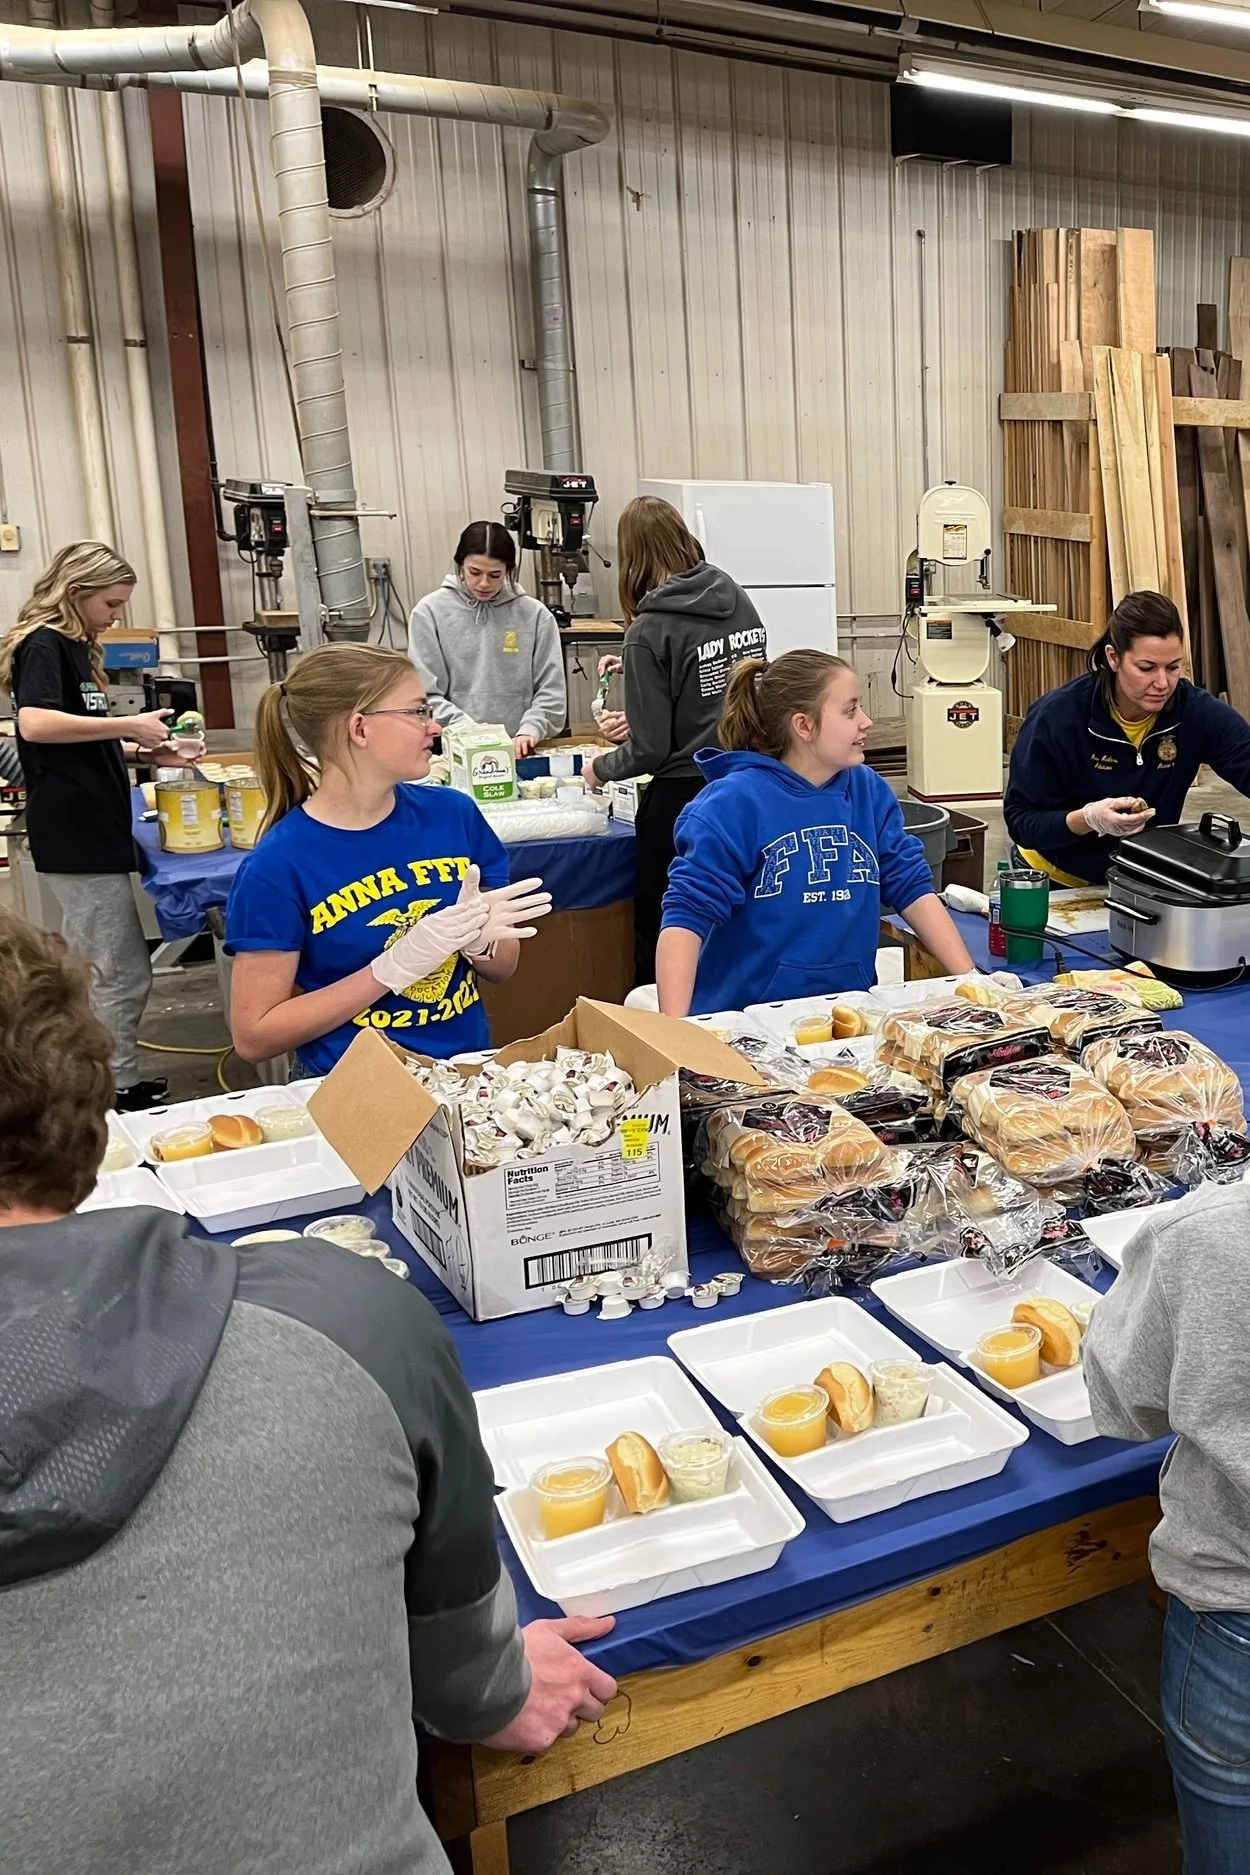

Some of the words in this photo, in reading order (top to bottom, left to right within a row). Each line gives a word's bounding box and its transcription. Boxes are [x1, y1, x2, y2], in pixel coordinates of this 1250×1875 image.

[697, 638, 724, 662] LADY
[4, 791, 27, 801] JE
[753, 825, 880, 899] FFA
[310, 867, 409, 935] ANNA
[803, 891, 827, 903] EST.
[409, 969, 452, 994] DUCATION
[507, 1166, 549, 1178] Nutrition
[507, 1175, 534, 1185] Facts
